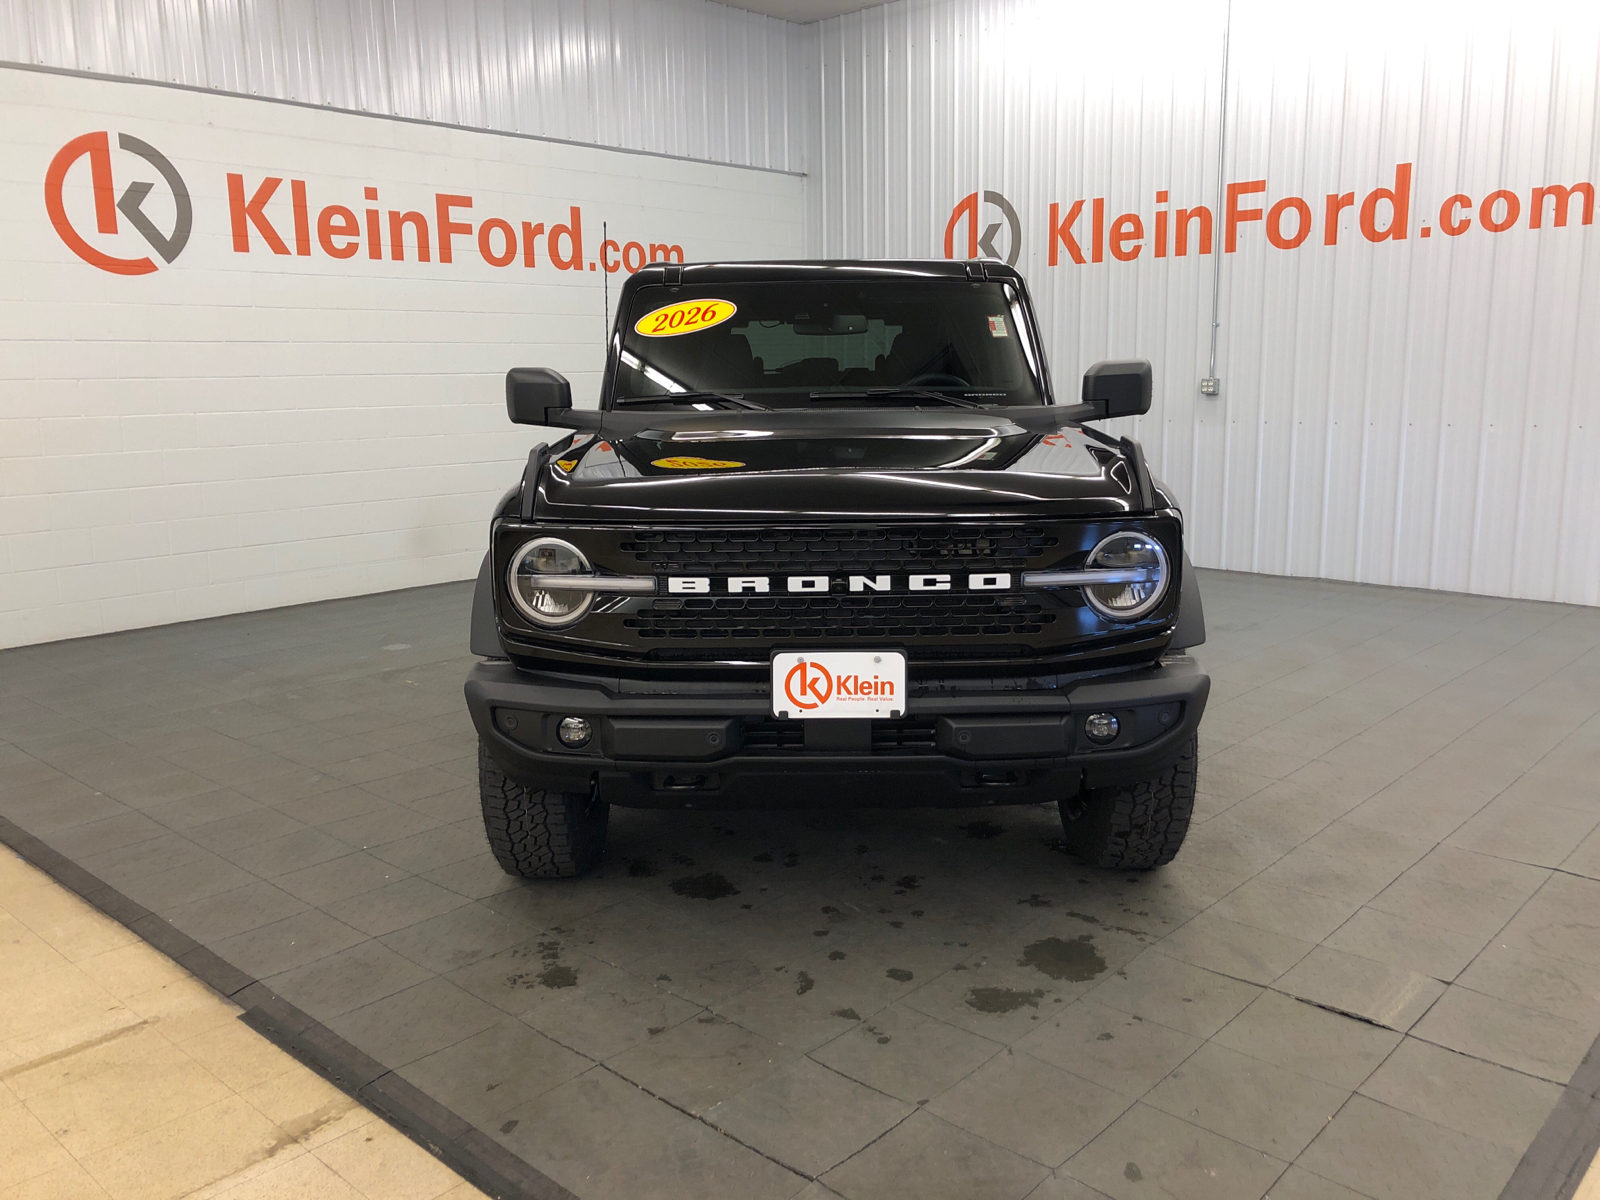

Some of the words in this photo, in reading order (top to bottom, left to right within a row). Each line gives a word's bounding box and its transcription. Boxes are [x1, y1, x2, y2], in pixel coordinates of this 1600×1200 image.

[226, 172, 685, 275] KleinFord.com
[1047, 162, 1595, 267] KleinFord.com
[652, 303, 719, 333] 2026
[668, 573, 1011, 593] BRONCO
[836, 675, 894, 695] Klein
